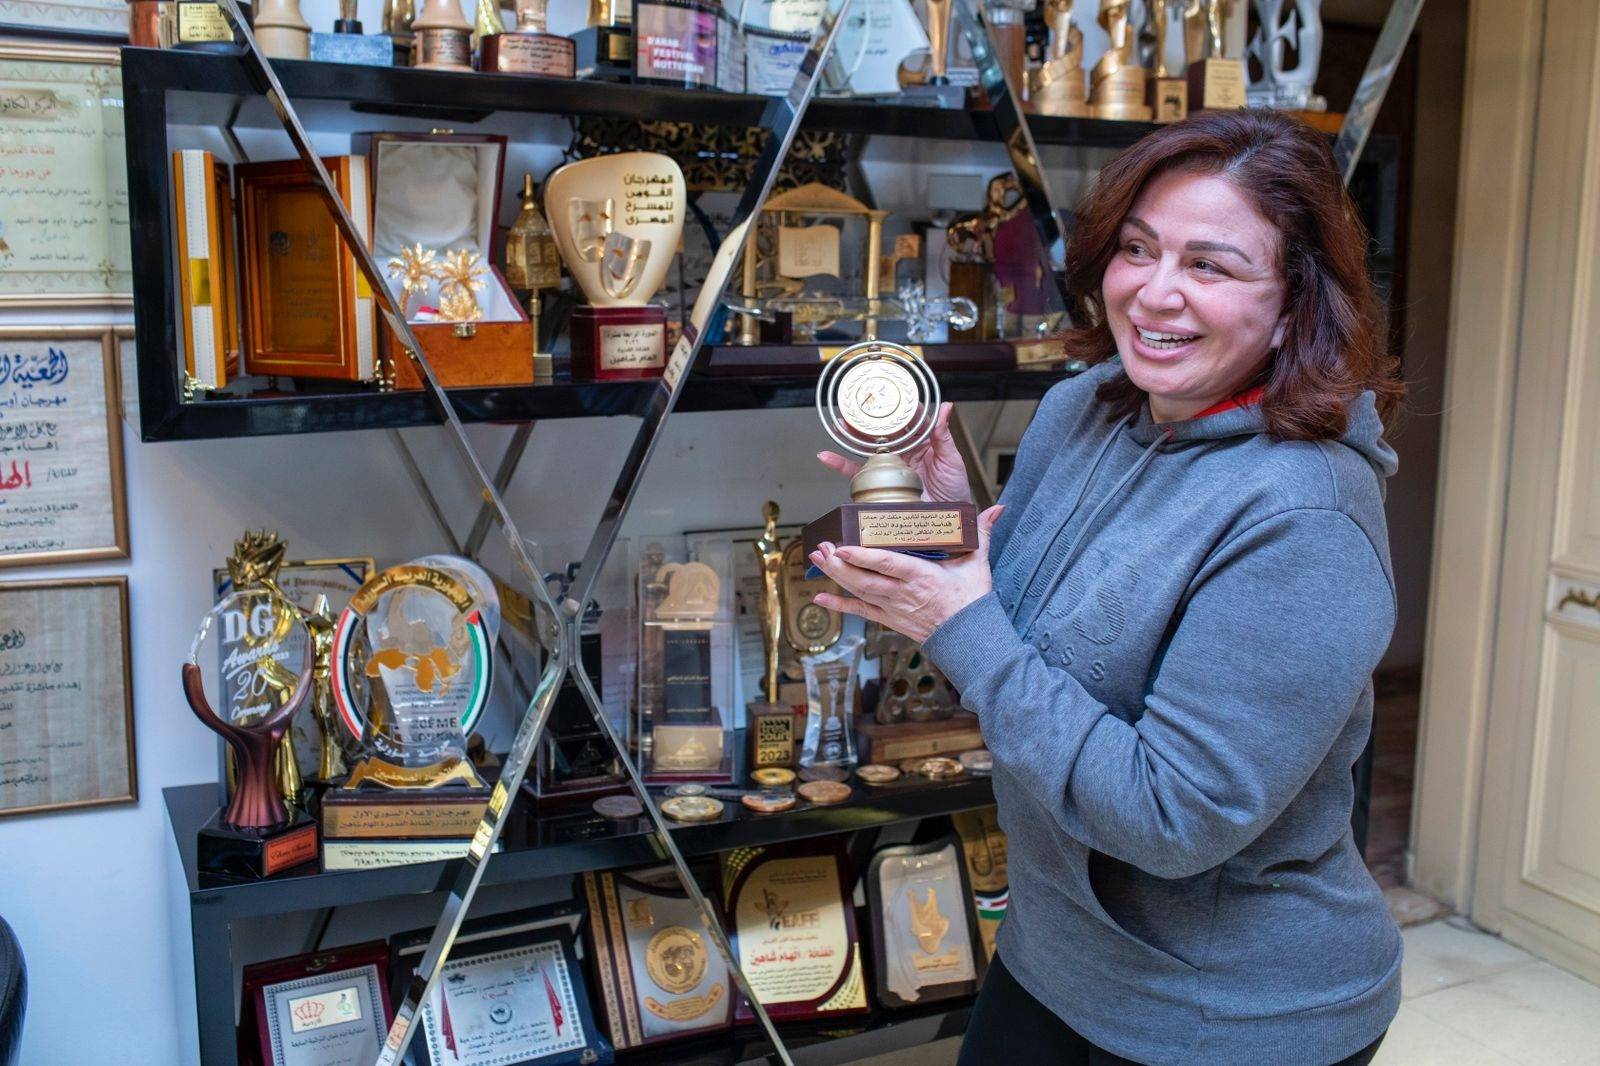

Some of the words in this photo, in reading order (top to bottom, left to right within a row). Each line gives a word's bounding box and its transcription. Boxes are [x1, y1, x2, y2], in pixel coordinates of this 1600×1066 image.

[623, 174, 673, 184] المهرجان
[625, 201, 674, 211] للمسرح
[222, 601, 276, 644] DG
[233, 667, 268, 702] 20
[759, 750, 790, 762] 2023
